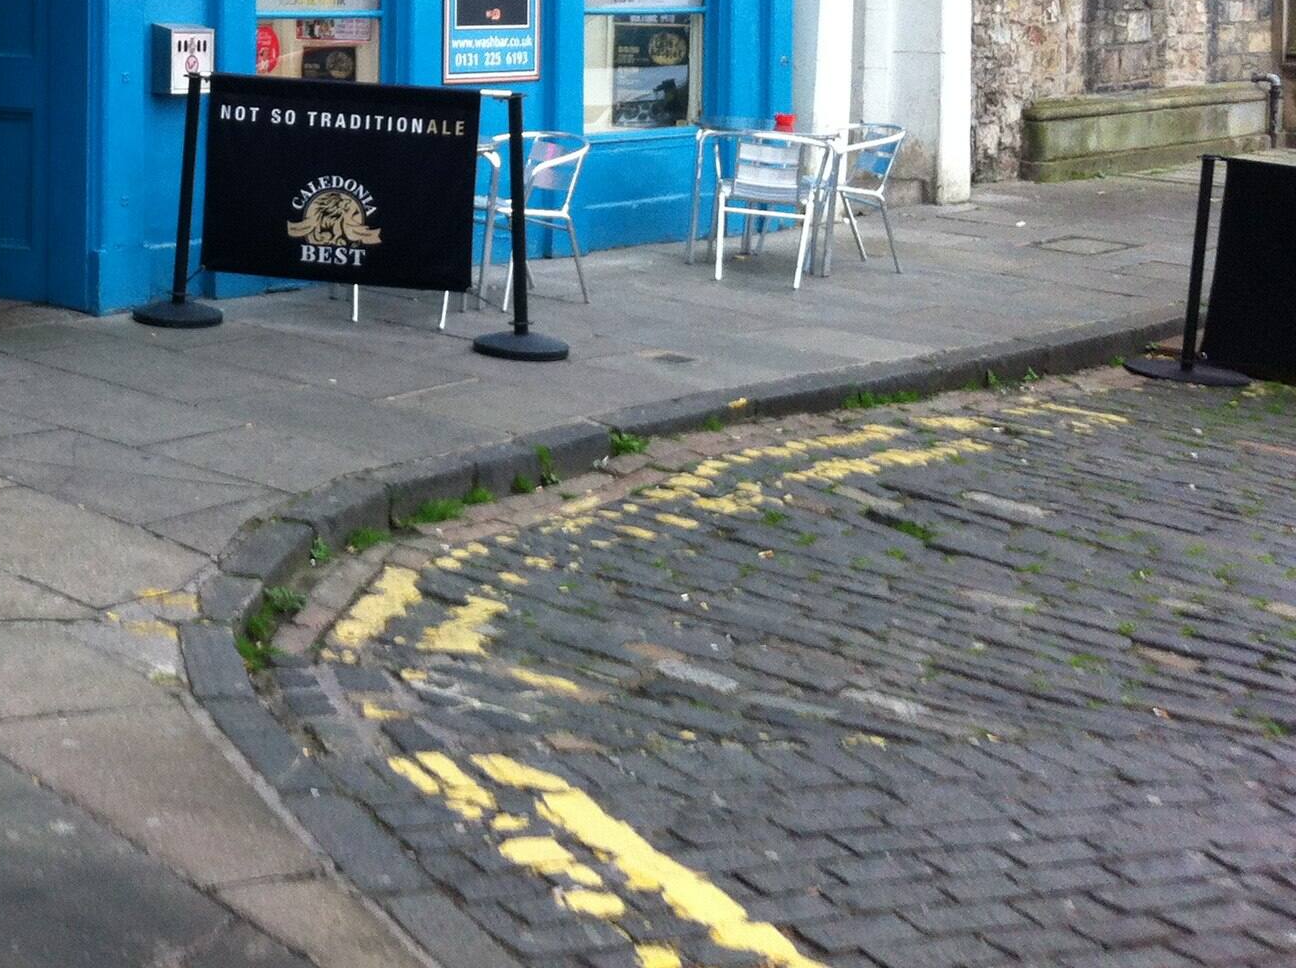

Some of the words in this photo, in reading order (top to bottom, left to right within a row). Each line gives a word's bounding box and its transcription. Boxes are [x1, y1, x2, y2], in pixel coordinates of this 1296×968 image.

[452, 35, 533, 49] www.washbar.co.uk
[455, 52, 478, 66] 0131
[484, 52, 501, 66] 225
[506, 51, 528, 65] 6193
[220, 104, 259, 122] NOT
[271, 108, 296, 125] SO
[307, 111, 466, 136] TRADITIONALE
[291, 175, 377, 217] CALEDONIA
[300, 244, 366, 266] BEST
